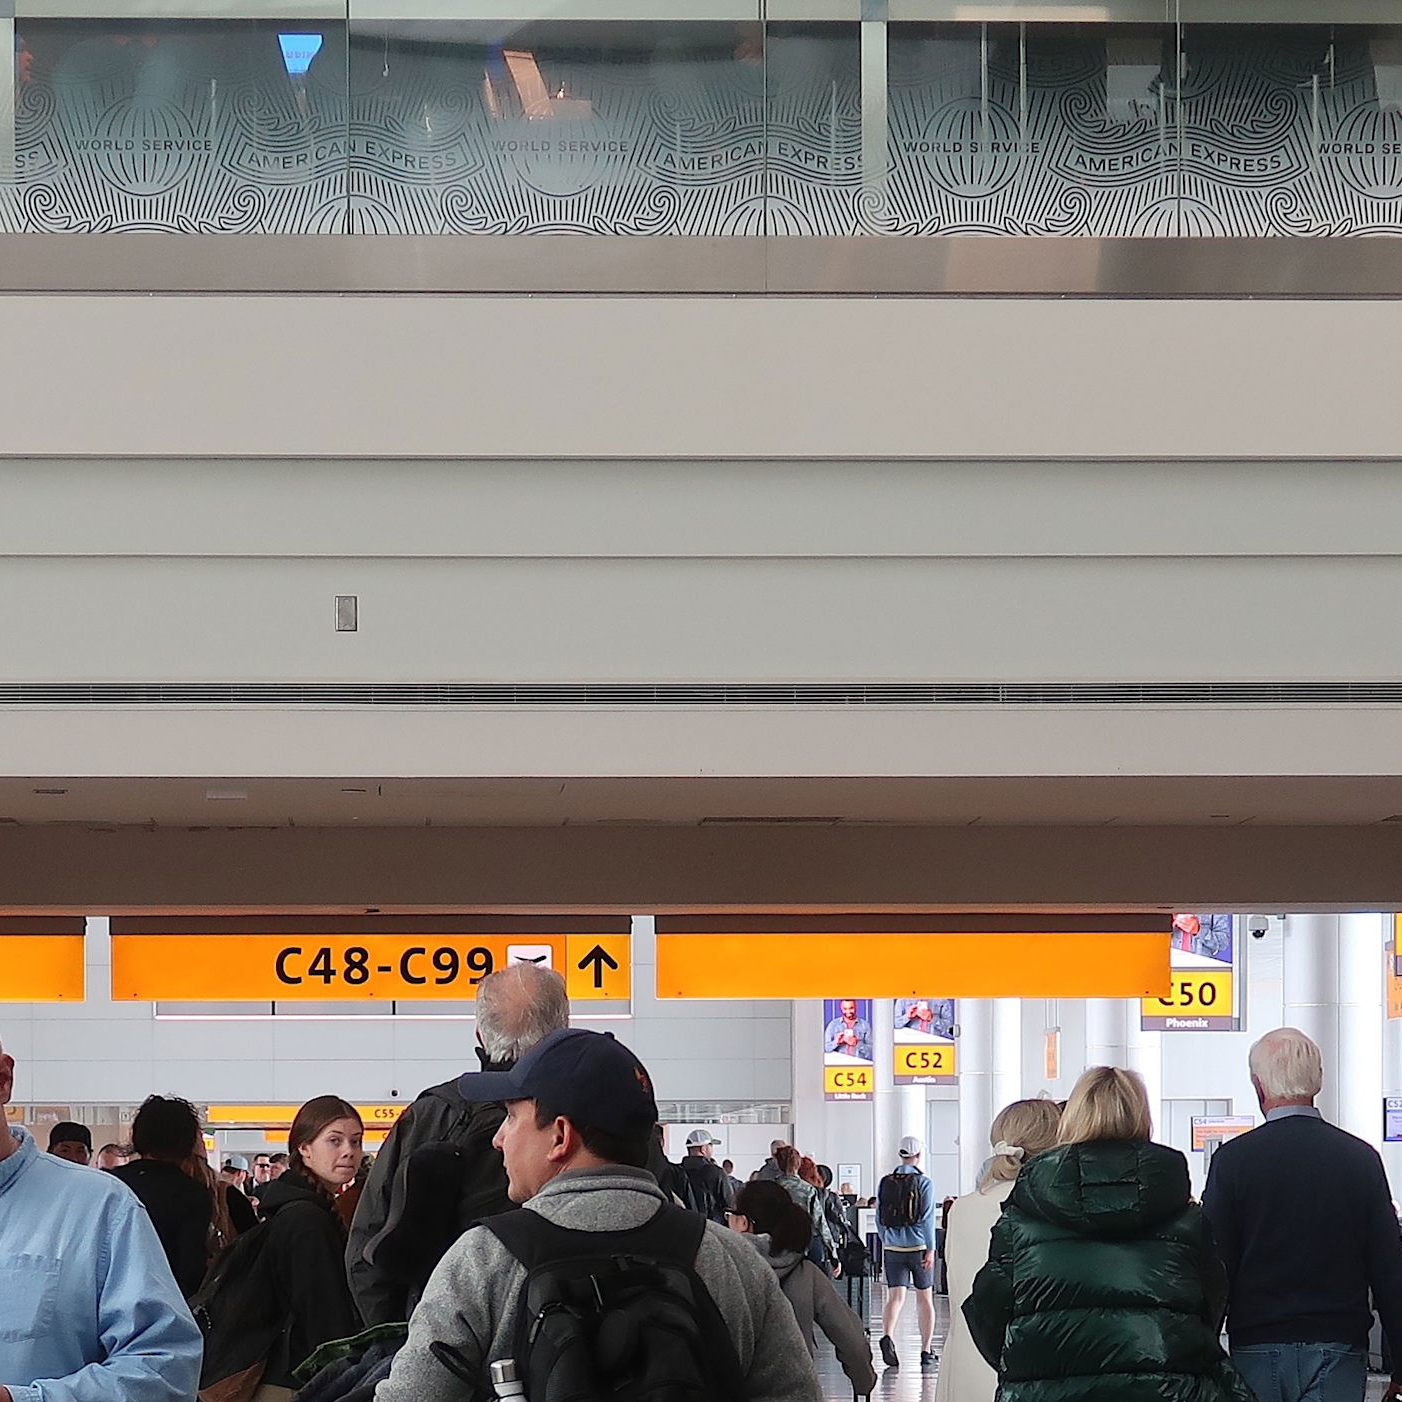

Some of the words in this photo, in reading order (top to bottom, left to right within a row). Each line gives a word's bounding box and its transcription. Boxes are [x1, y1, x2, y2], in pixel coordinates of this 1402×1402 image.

[75, 139, 135, 152] WORLD
[141, 139, 213, 152] SERVICE
[491, 140, 551, 153] WORLD
[557, 140, 629, 153] SERVICE
[903, 141, 963, 153] WORLD
[1317, 142, 1375, 155] WORLD
[248, 140, 356, 169] AMERICAN
[365, 141, 457, 169] EXPRESS
[663, 142, 768, 171] AMERICAN
[1074, 142, 1182, 172] AMERICAN
[1190, 143, 1282, 172] EXPRESS
[274, 946, 494, 985] C48-C99
[1165, 1017, 1209, 1028] Phoenix
[905, 1052, 943, 1068] C52
[833, 1072, 867, 1087] C54
[912, 1075, 937, 1084] Austin
